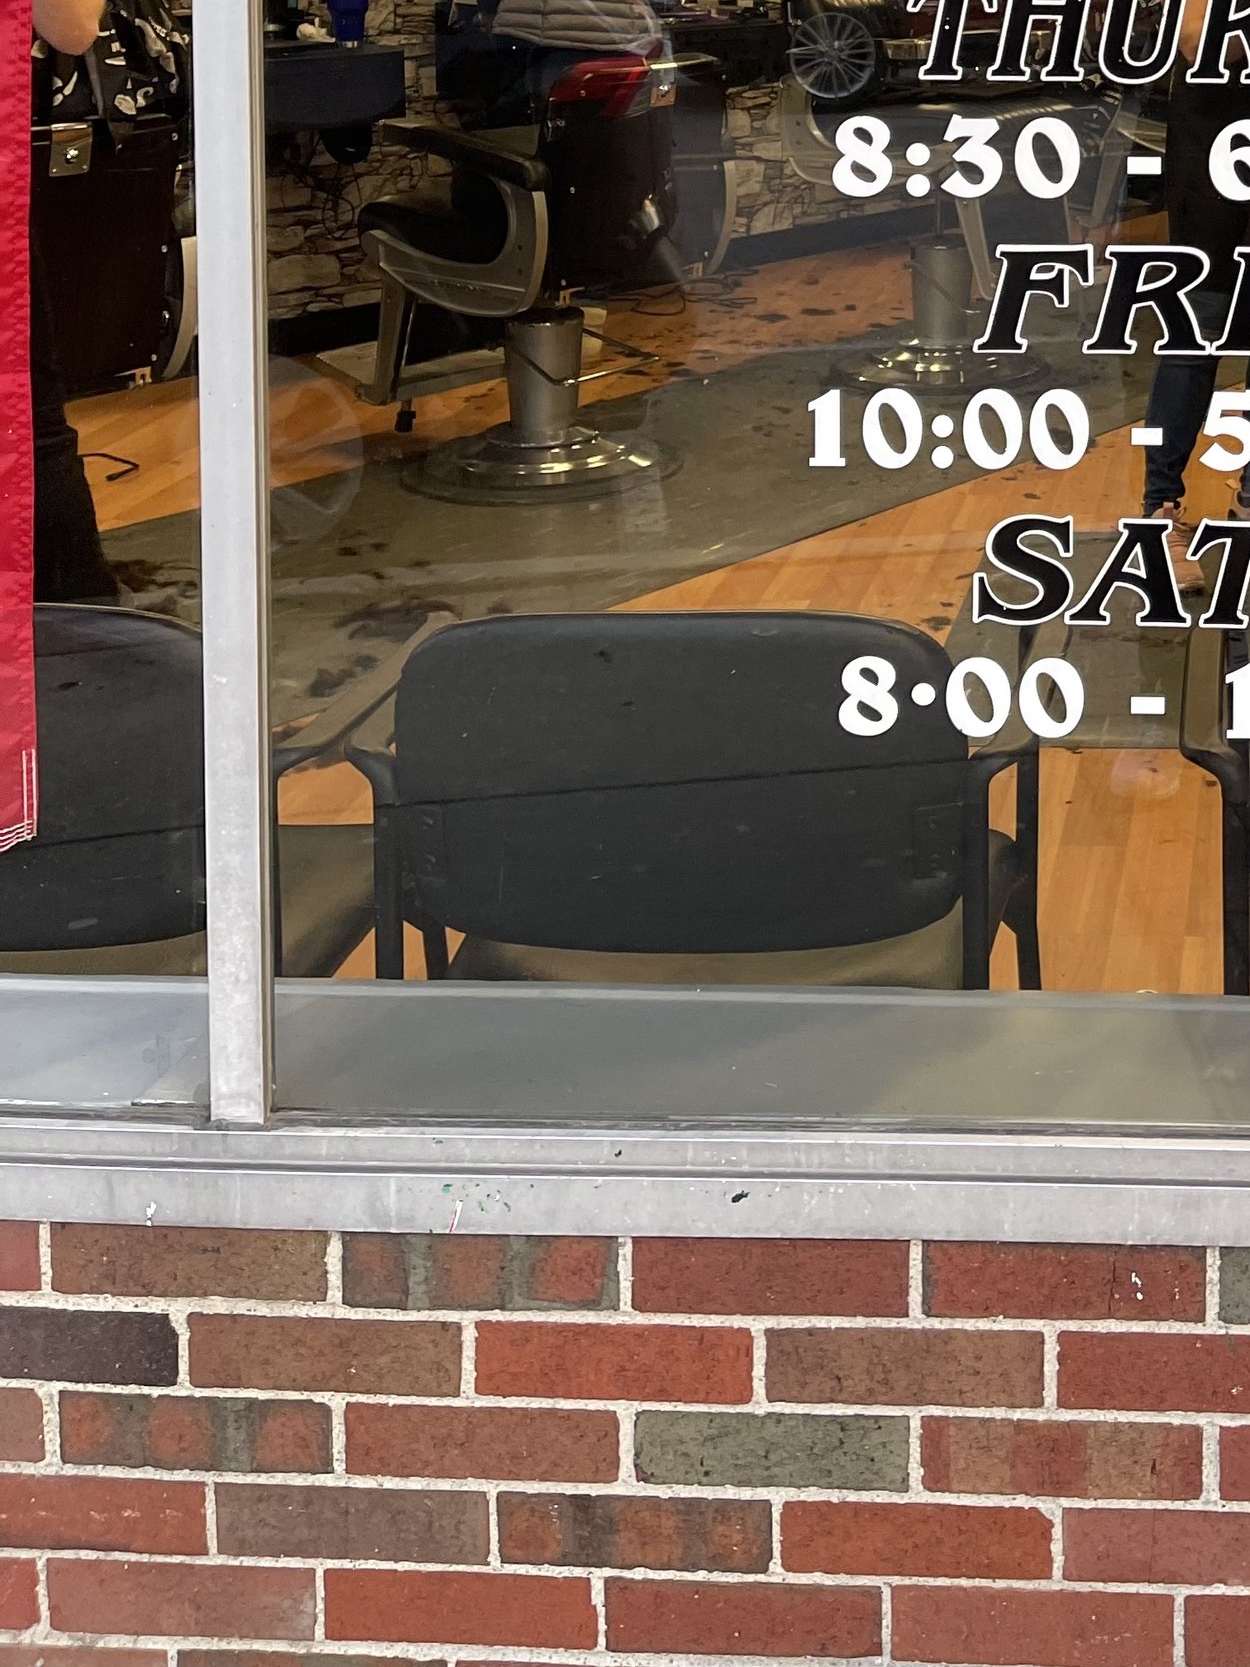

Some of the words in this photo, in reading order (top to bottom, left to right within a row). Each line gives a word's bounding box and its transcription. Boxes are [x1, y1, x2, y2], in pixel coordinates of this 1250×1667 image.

[831, 114, 1083, 199] 8:30
[1126, 156, 1162, 176] -
[806, 387, 1090, 471] 10:00
[1130, 427, 1164, 446] -
[1130, 695, 1166, 715] -
